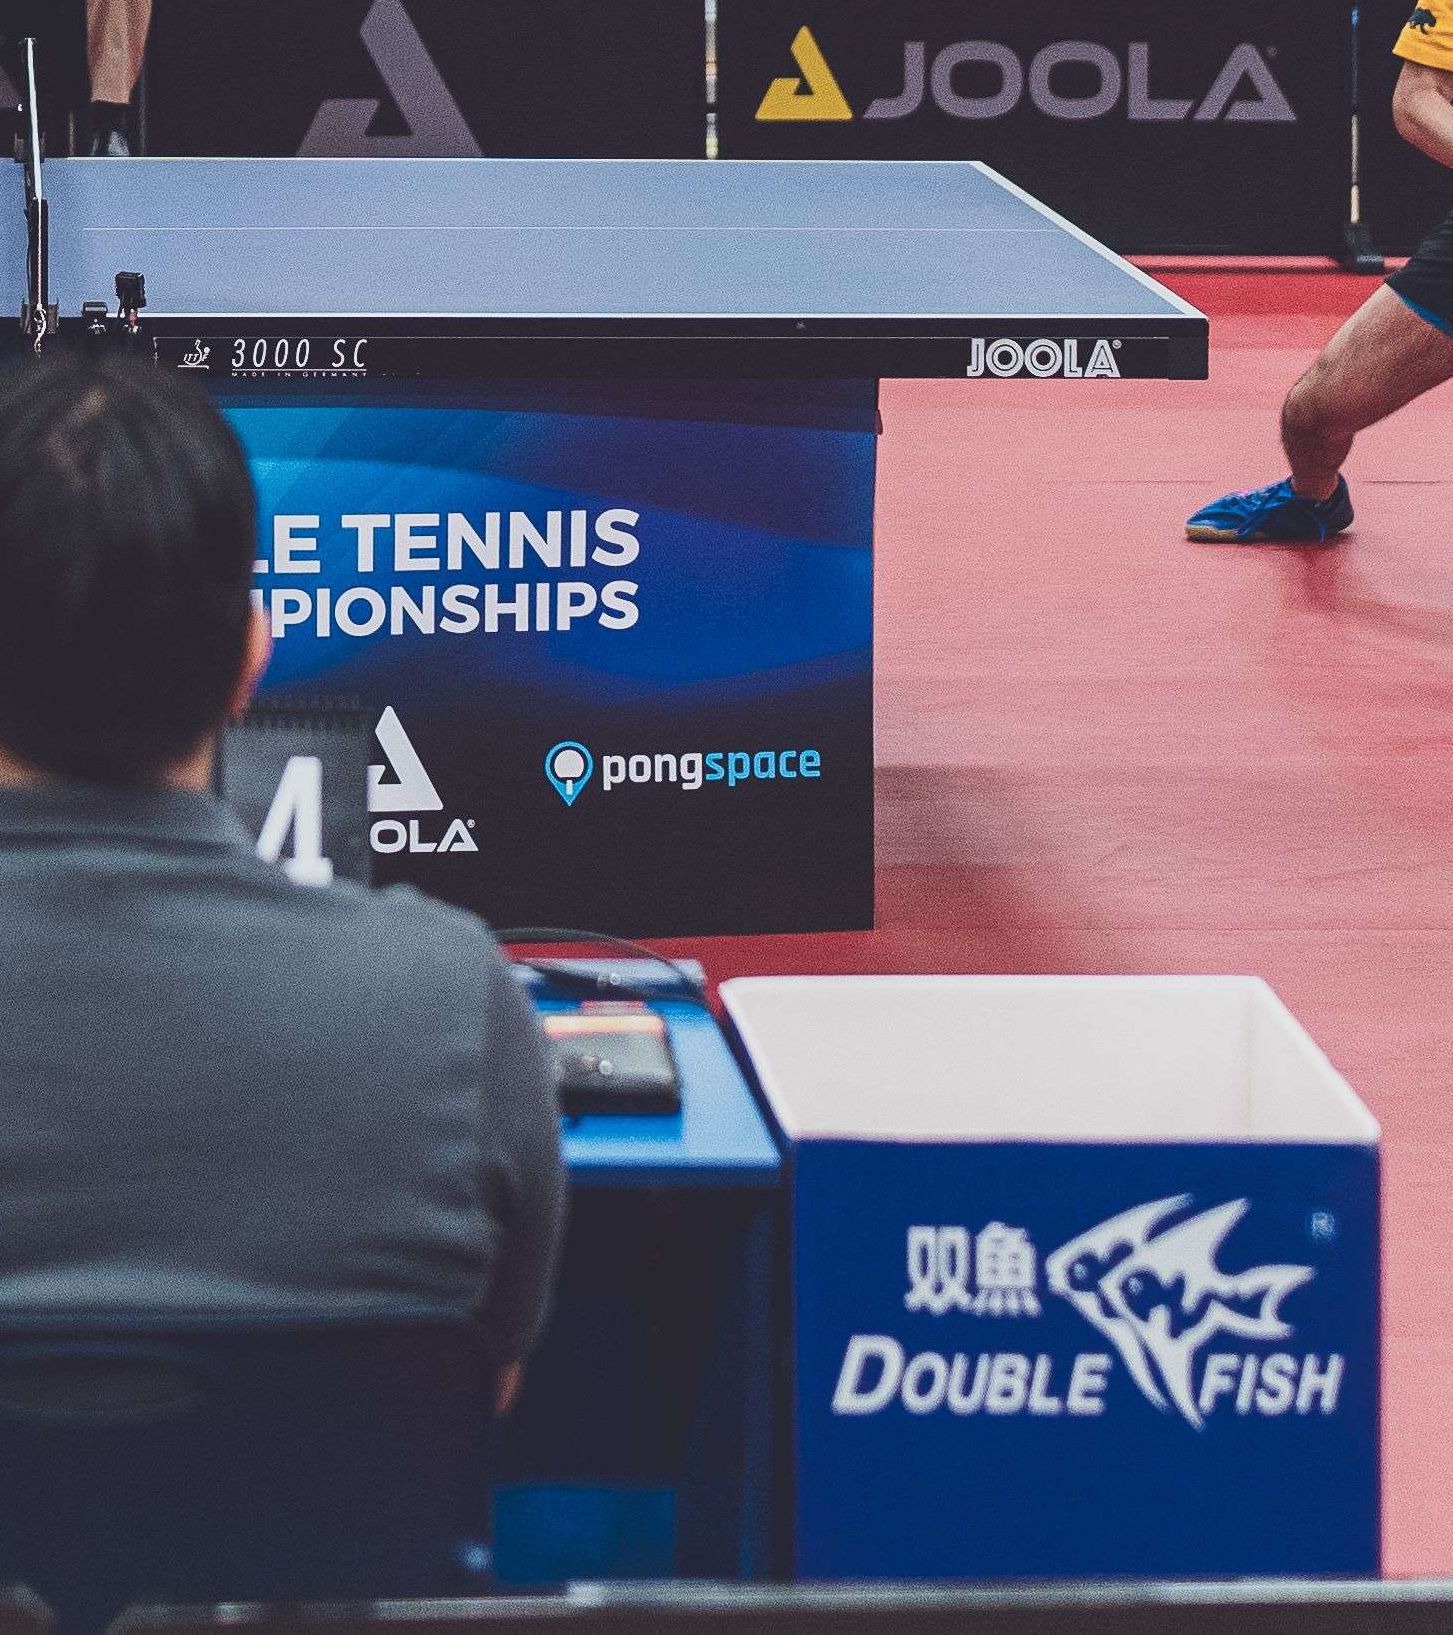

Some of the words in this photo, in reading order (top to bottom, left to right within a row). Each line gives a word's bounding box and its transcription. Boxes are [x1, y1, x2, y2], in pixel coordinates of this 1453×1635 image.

[862, 40, 1295, 121] JOOLA
[231, 338, 310, 368] 3000
[332, 338, 367, 367] SC
[967, 338, 1120, 378] JOOLA
[342, 509, 641, 574] TENNIS
[250, 581, 639, 639] PIONSHIPS
[603, 747, 822, 791] pongspace
[256, 756, 333, 887] 4
[370, 819, 479, 854] OLA
[831, 1333, 1112, 1415] DOUBLE
[1197, 1353, 1344, 1415] FISH
